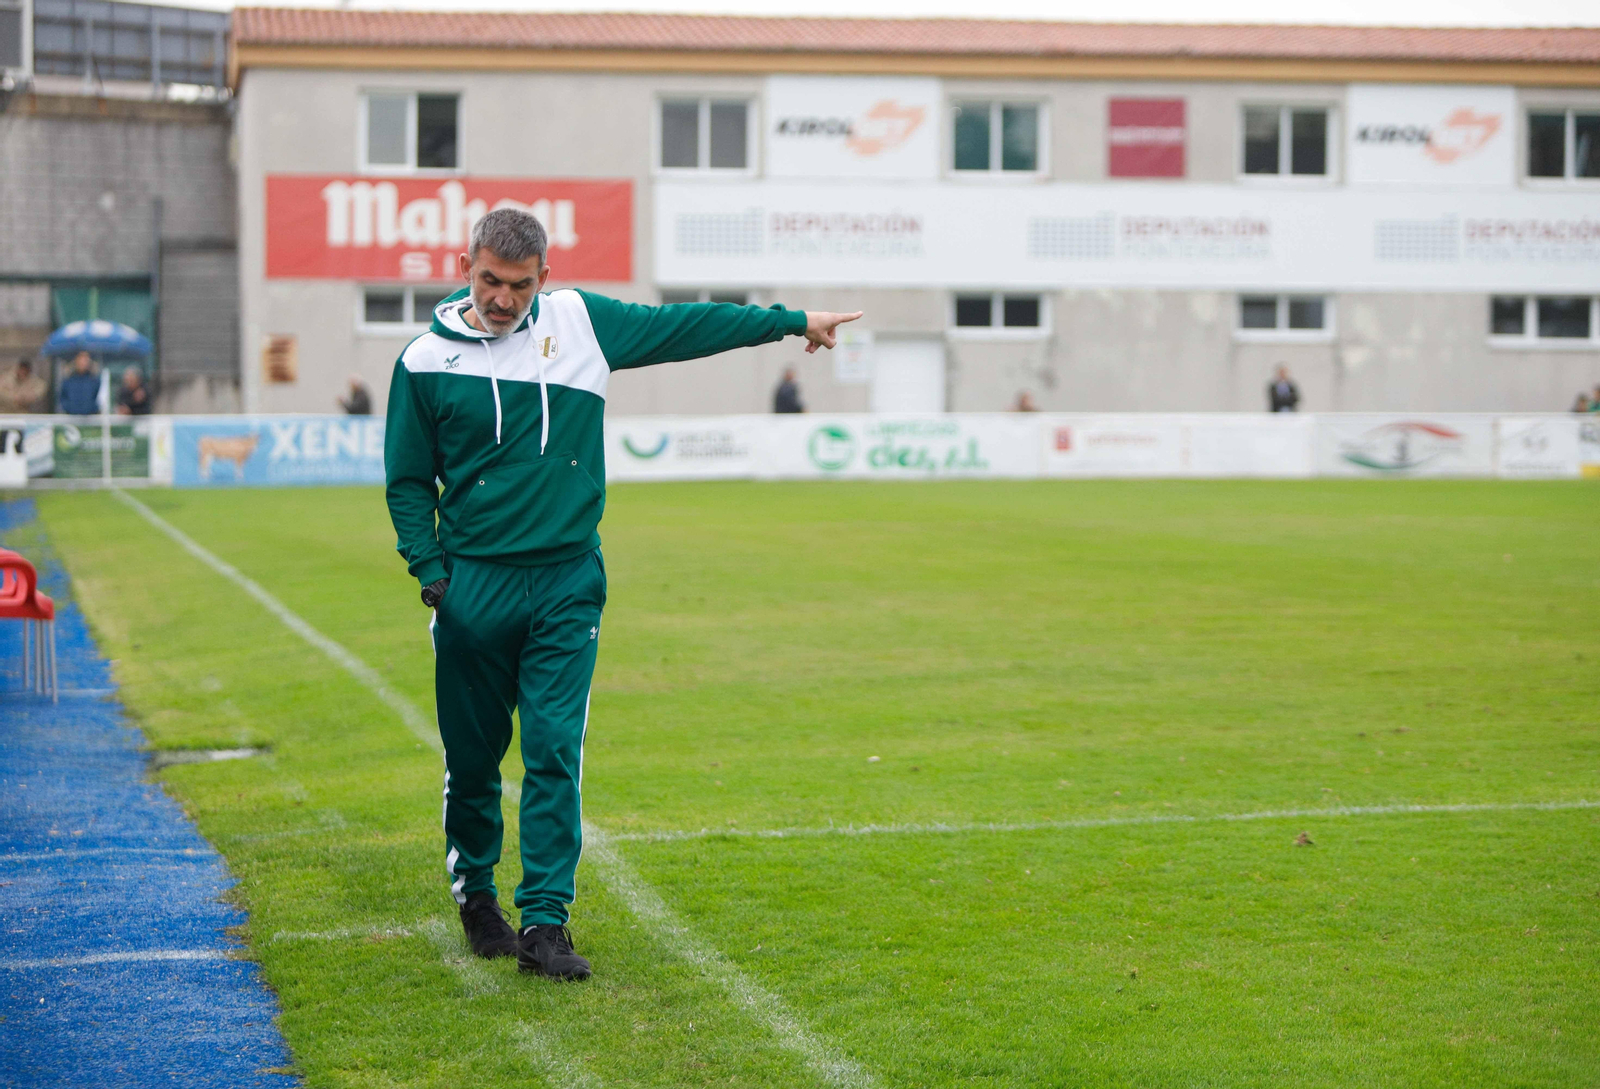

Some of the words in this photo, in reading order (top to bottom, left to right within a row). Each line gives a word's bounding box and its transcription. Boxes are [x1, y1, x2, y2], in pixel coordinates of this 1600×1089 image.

[769, 207, 921, 234] DEPUTACIÓN
[1120, 211, 1271, 238] DEPUTACIÓN
[445, 362, 460, 370] ZICO
